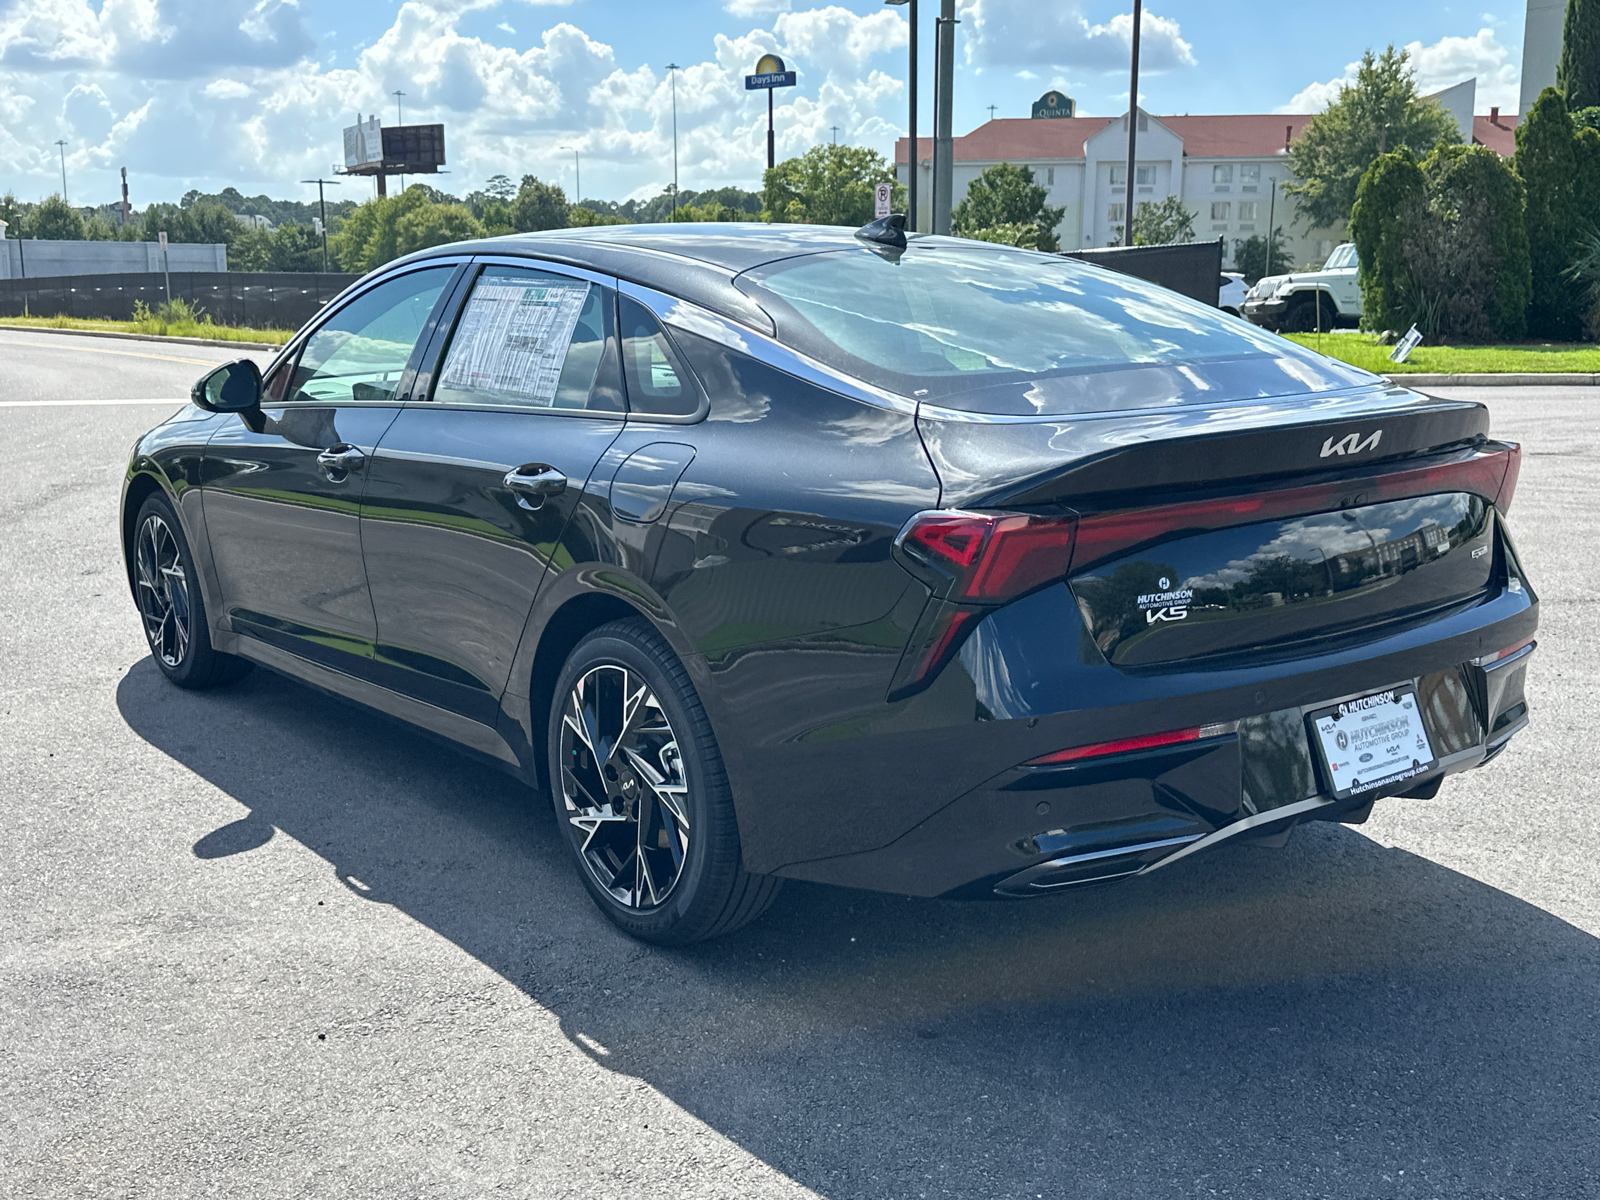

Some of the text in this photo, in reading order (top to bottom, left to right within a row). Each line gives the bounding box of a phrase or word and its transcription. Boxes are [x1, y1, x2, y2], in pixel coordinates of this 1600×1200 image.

[751, 75, 771, 85] Days
[772, 74, 786, 82] Inn
[1040, 108, 1071, 119] QUINTA
[1137, 590, 1193, 604] HUTCHINSON
[1139, 598, 1192, 609] AUTOMOTIVE GROUP
[1146, 605, 1188, 623] K5
[1349, 691, 1395, 713] HUTCHINSON
[1350, 715, 1410, 744] HUTCHINSON
[1354, 728, 1410, 751] AUTOMOTIVE GROUP
[1349, 765, 1429, 795] Hutchinsonautogroup.com
